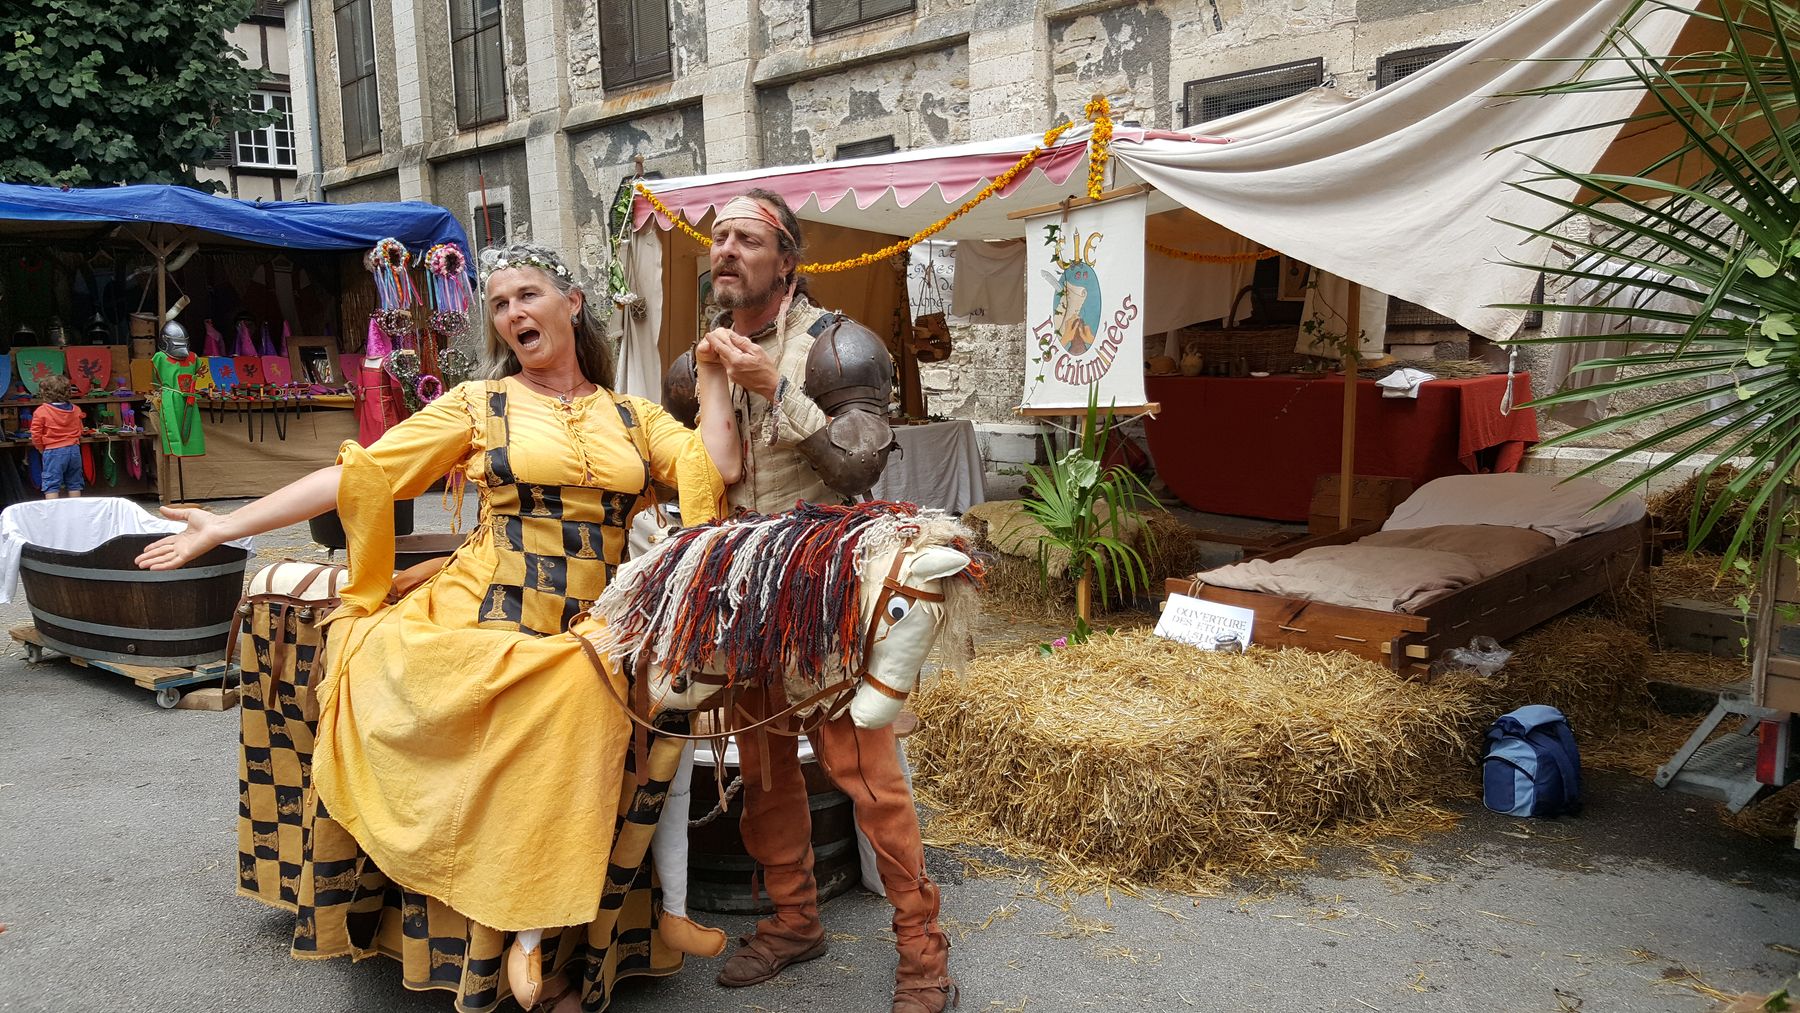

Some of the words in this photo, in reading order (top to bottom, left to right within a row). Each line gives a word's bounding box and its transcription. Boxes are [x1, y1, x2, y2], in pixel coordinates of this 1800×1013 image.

[1032, 315, 1059, 363] Les
[1054, 293, 1138, 386] Enluminées
[1172, 615, 1193, 627] DES
[1176, 607, 1247, 631] OUVERTURE
